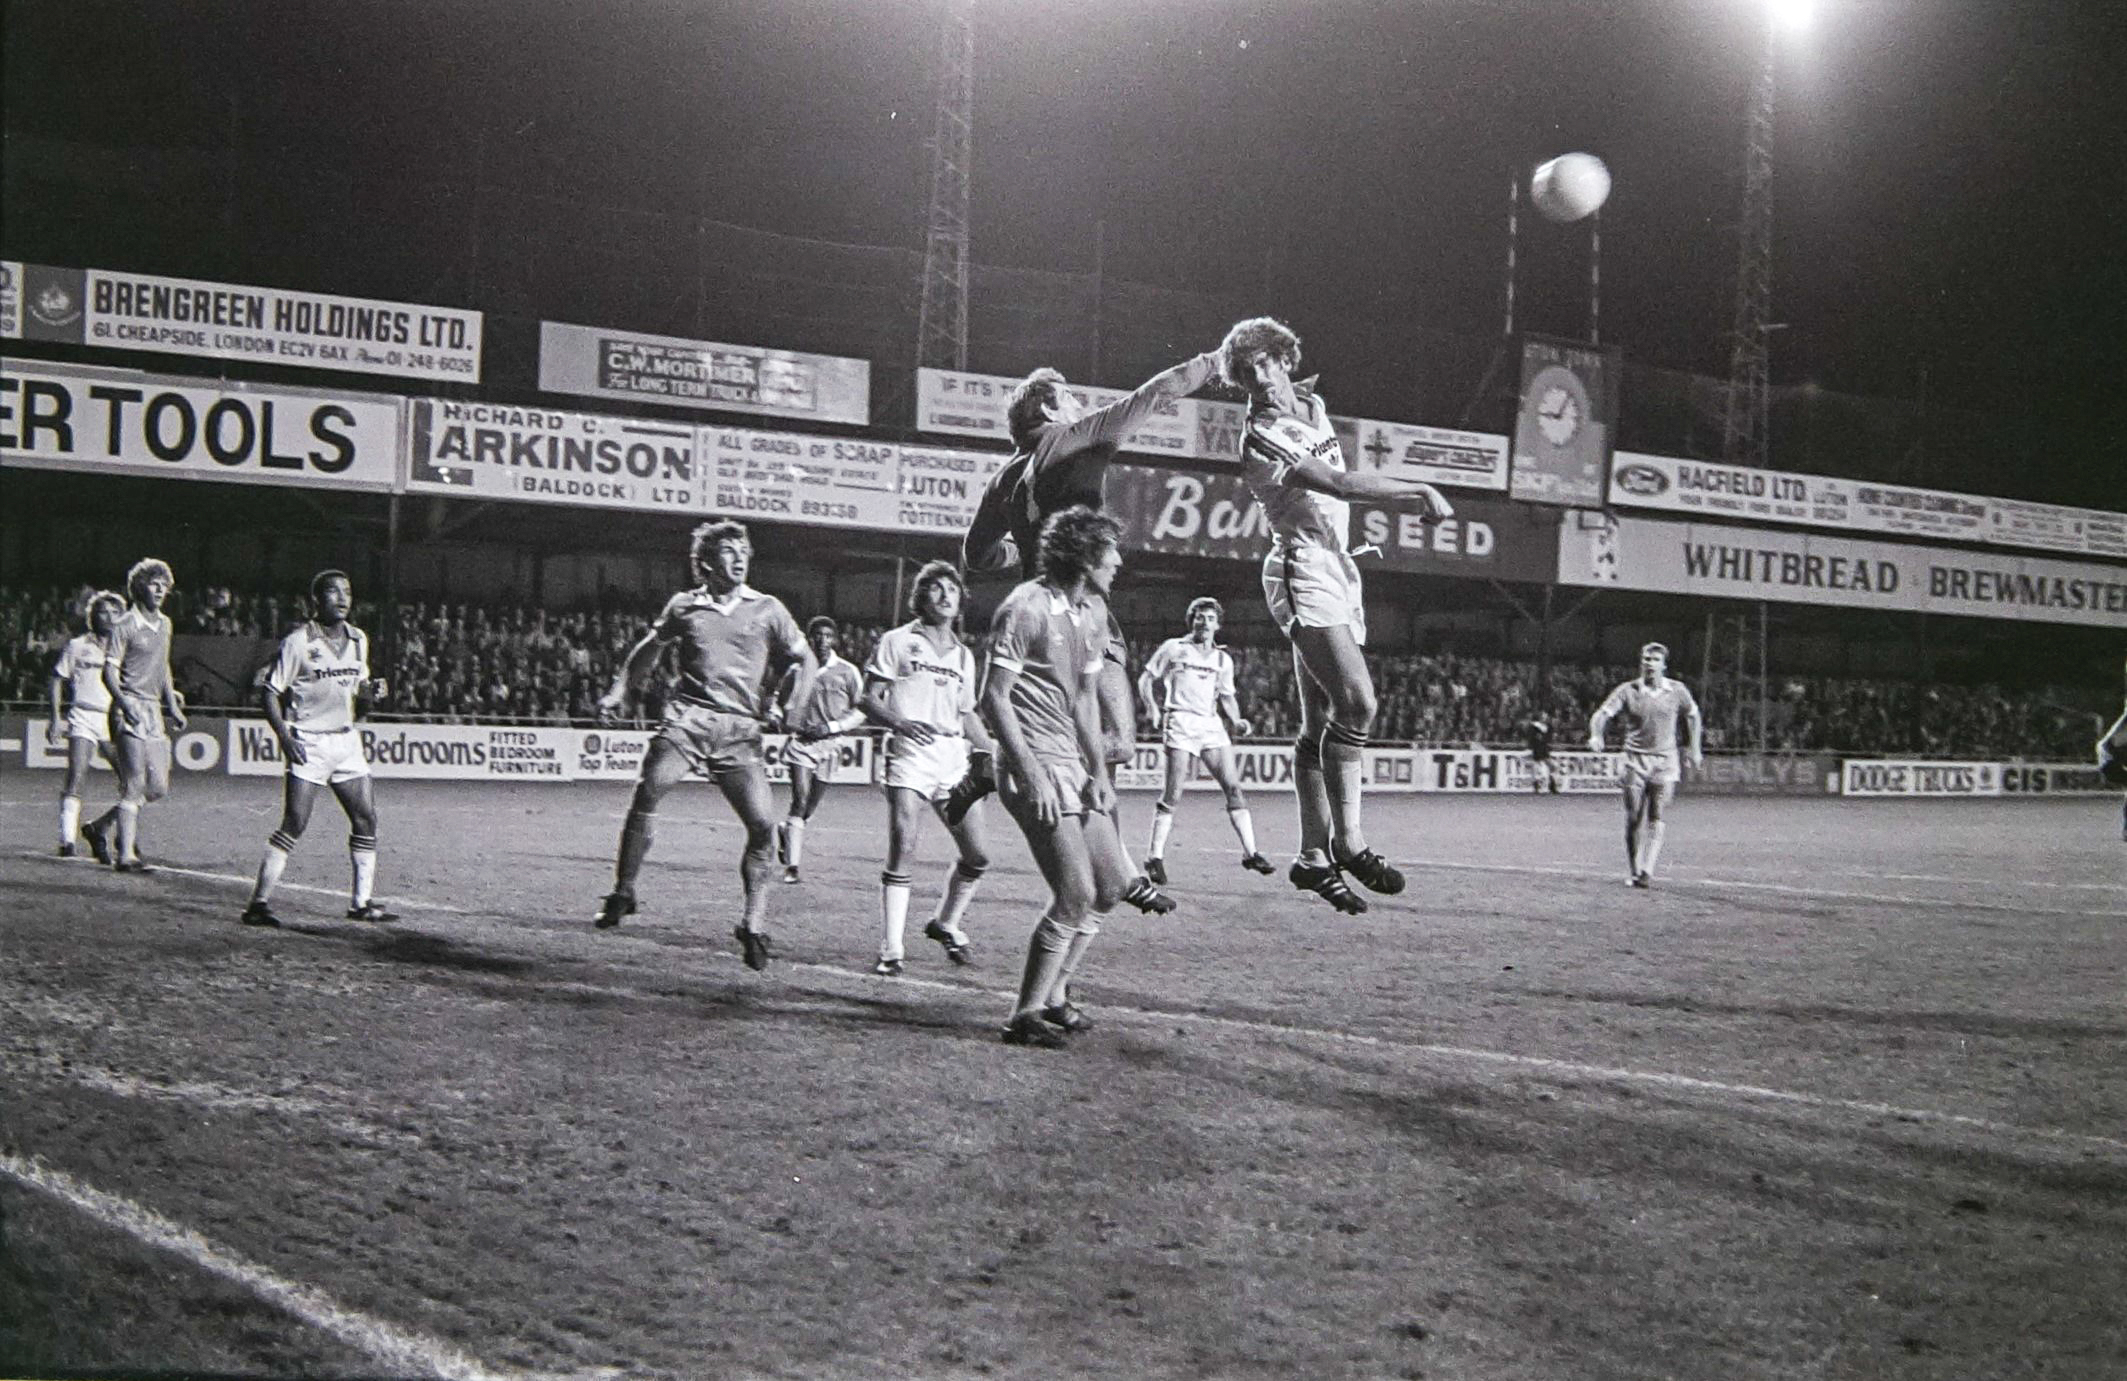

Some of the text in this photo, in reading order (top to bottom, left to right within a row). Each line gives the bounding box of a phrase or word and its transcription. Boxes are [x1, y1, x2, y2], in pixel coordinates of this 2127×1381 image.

[94, 278, 474, 350] BRENGREEN HOLDINGS LTD.
[214, 333, 275, 354] LONDON
[88, 385, 357, 474] TOOLS
[652, 486, 692, 504] LTD
[716, 493, 794, 513] BALDOCK
[1362, 509, 1494, 556] SEED
[1681, 541, 1900, 593] WHITBREAD
[1929, 565, 2127, 613] BREWMASTE
[238, 727, 284, 763] Wa
[360, 730, 486, 766] Bedrooms
[489, 731, 538, 746] FITTED
[489, 746, 556, 760] BEDROOM
[489, 761, 563, 776] FURNITURE
[2002, 766, 2050, 792] CIS
